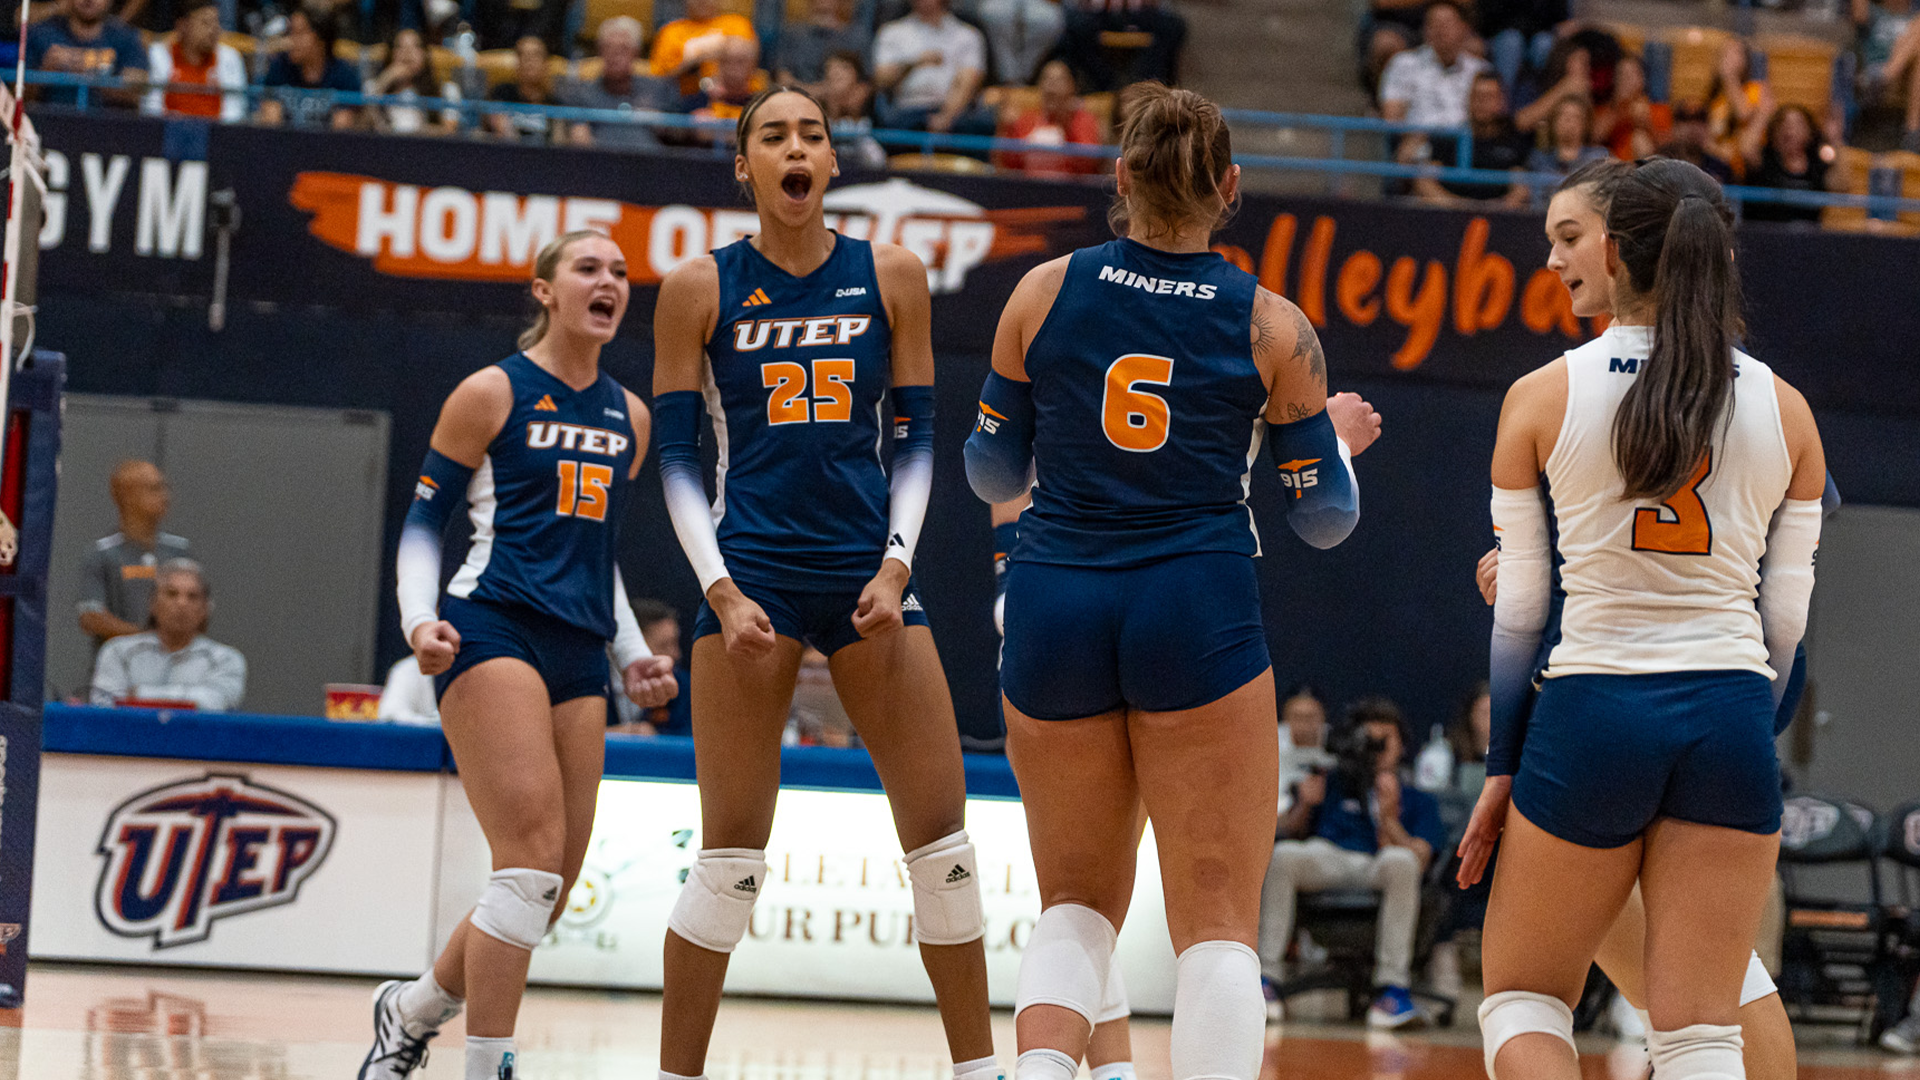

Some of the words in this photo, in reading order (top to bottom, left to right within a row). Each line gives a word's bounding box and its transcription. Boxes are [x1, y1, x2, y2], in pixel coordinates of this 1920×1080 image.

[38, 149, 208, 260] GYM
[1098, 265, 1218, 300] MINERS
[733, 314, 872, 352] UTEP
[760, 358, 855, 426] 25
[1101, 353, 1174, 453] 6
[526, 421, 629, 457] UTEP
[556, 459, 614, 522] 15
[1280, 468, 1319, 489] 915
[111, 786, 323, 933] UTEP
